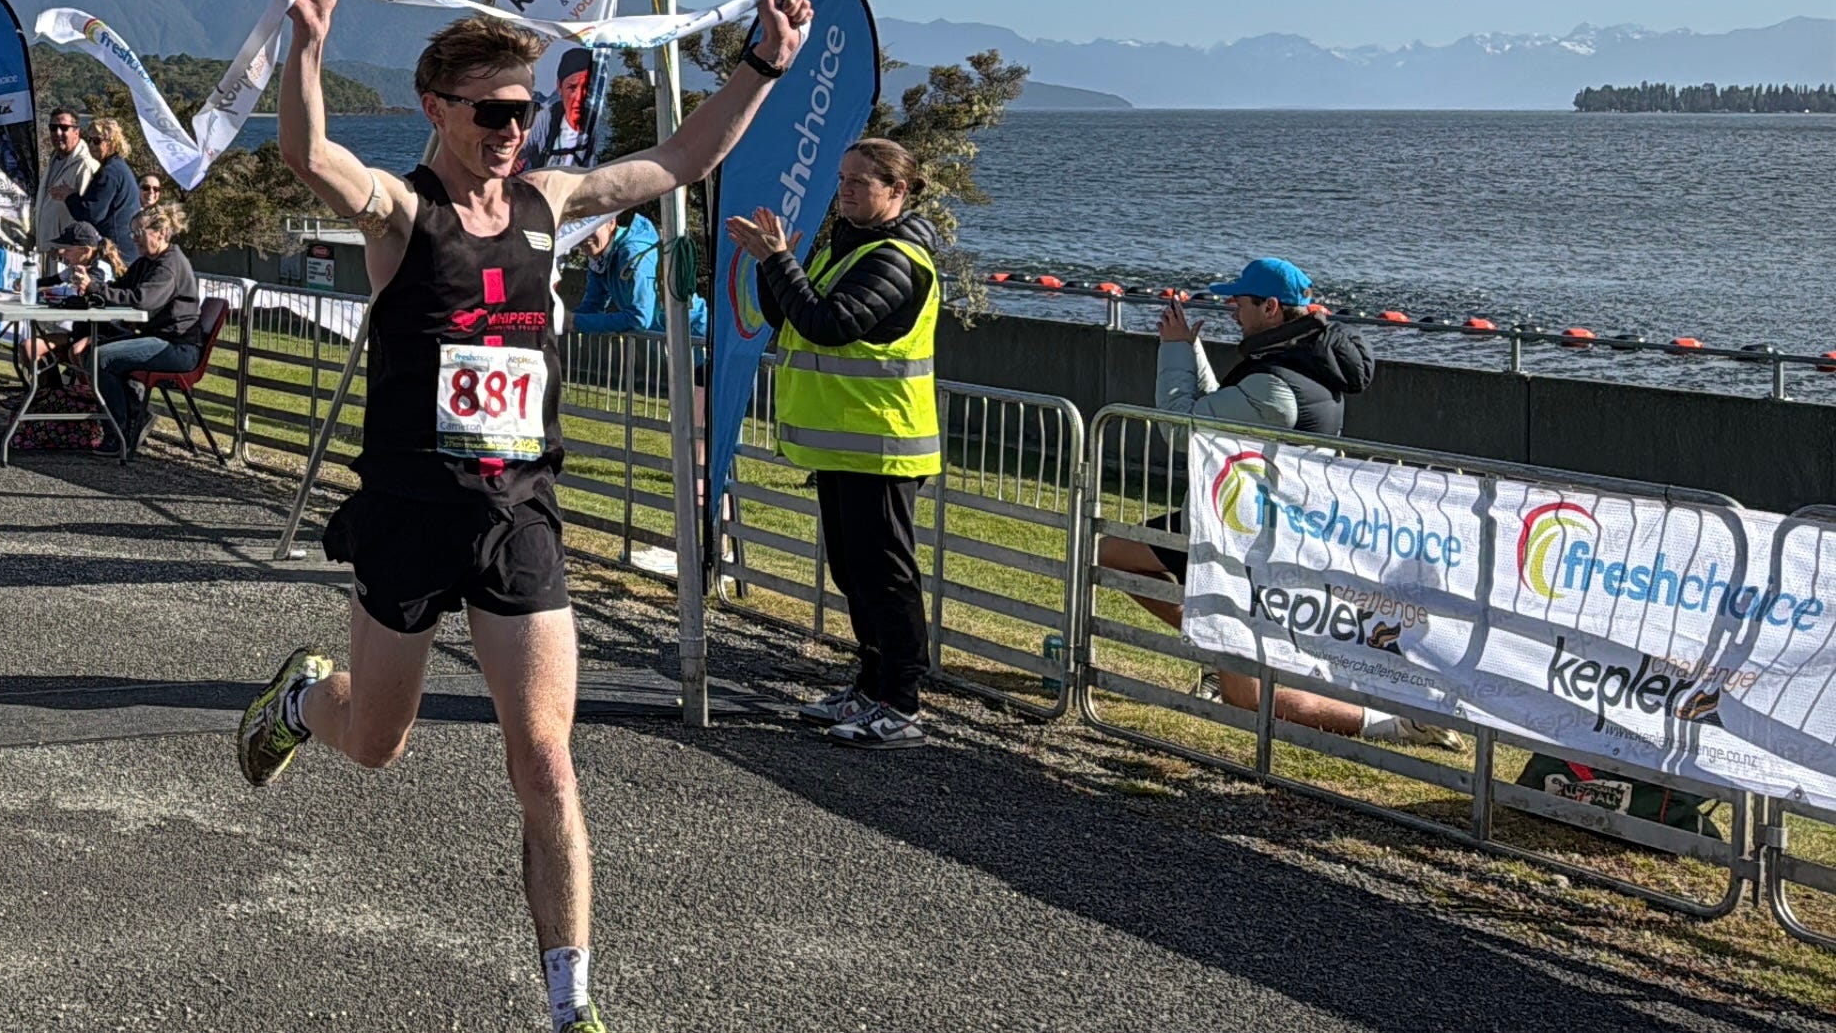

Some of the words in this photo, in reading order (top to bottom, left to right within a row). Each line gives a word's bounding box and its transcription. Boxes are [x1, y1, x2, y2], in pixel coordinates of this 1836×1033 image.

[487, 312, 546, 325] WHIPPETS
[450, 368, 531, 419] 881
[440, 421, 482, 431] Cameron
[1254, 483, 1462, 567] freshchoice
[1246, 566, 1373, 653] kepler
[1332, 583, 1428, 628] challenge
[1563, 540, 1824, 631] freshchoice
[1547, 635, 1697, 732] kepler
[1651, 655, 1757, 694] challenge
